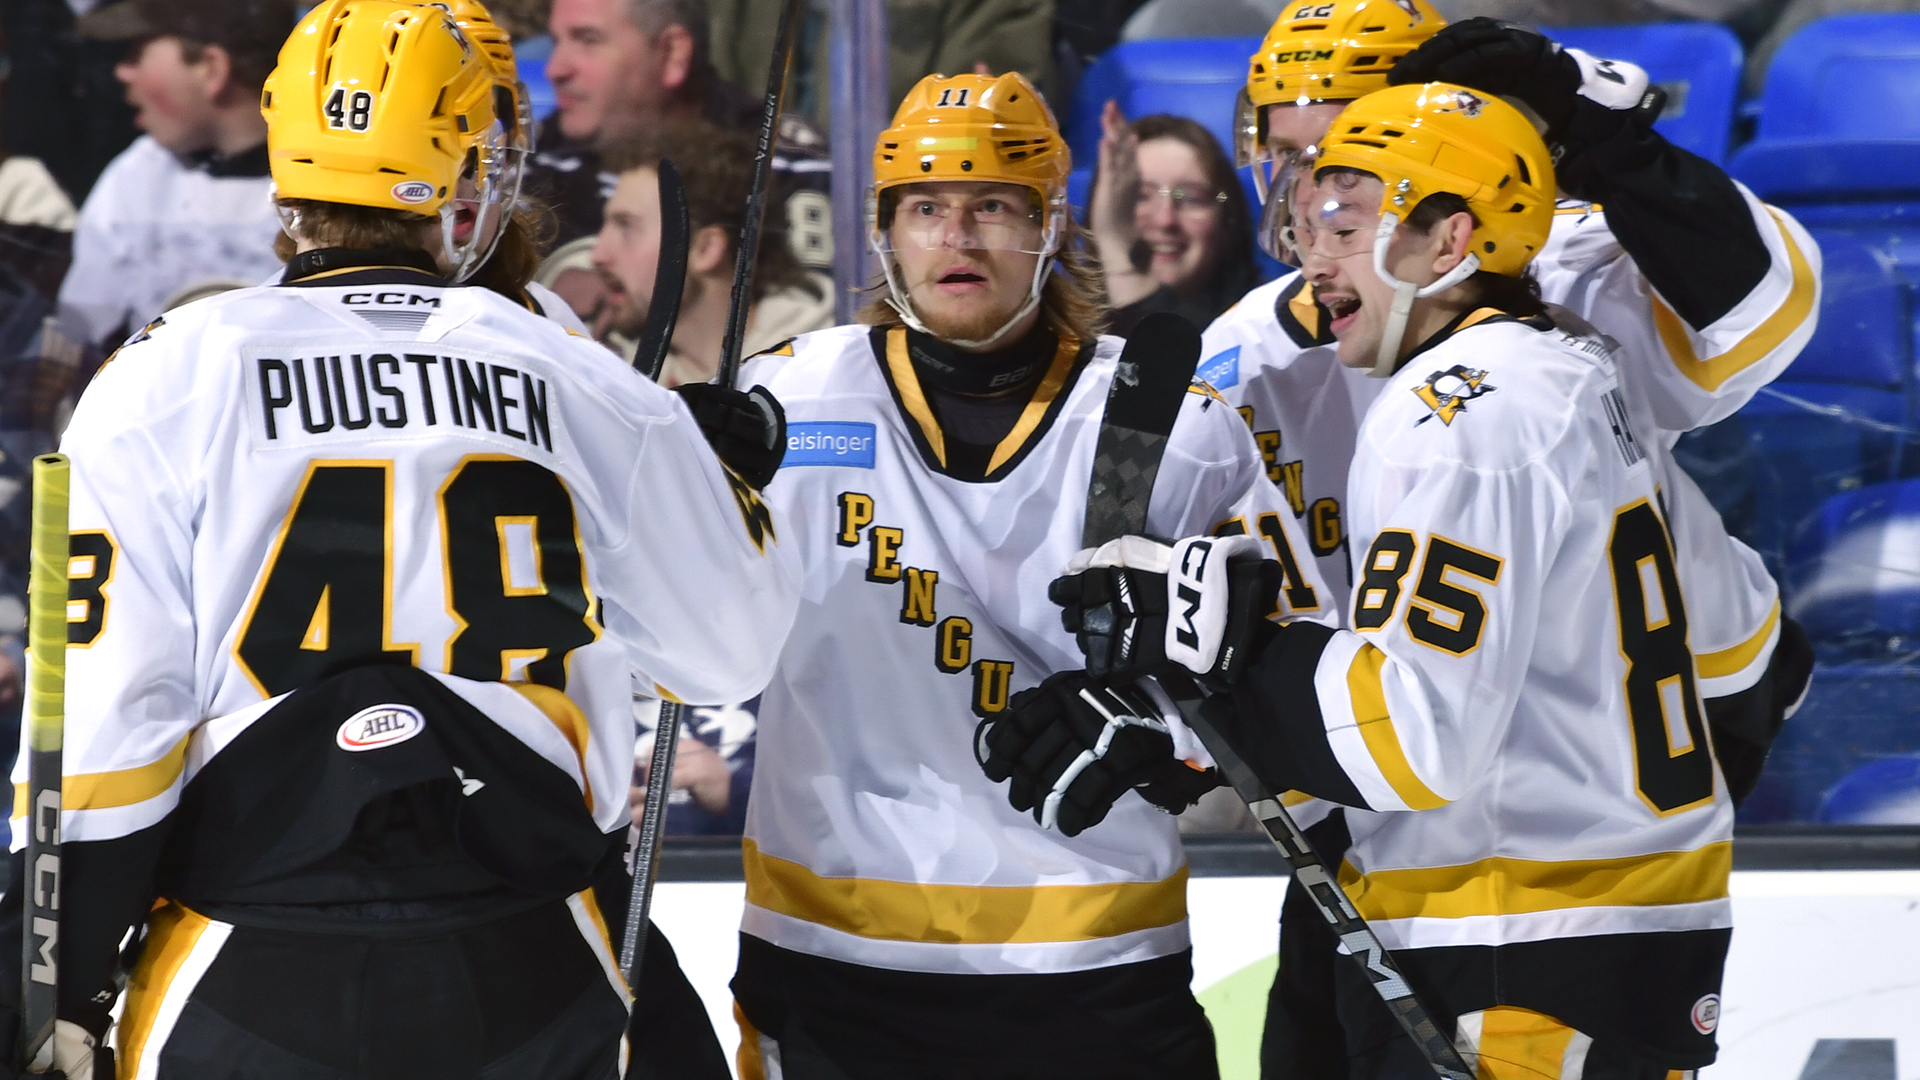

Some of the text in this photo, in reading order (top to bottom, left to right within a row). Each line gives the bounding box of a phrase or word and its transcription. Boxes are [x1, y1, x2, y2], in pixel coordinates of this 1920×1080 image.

[1293, 4, 1335, 20] 22
[1276, 50, 1335, 64] CCM
[323, 87, 372, 133] 48
[936, 88, 970, 108] 11
[400, 187, 427, 197] AHL
[340, 292, 441, 307] CCM
[257, 353, 553, 453] PUUSTINEN
[230, 453, 602, 701] 48
[1353, 527, 1506, 658] 85
[1606, 484, 1715, 818] 8
[359, 711, 406, 741] AHL
[31, 788, 61, 986] CCM
[1249, 799, 1414, 1000] CCM
